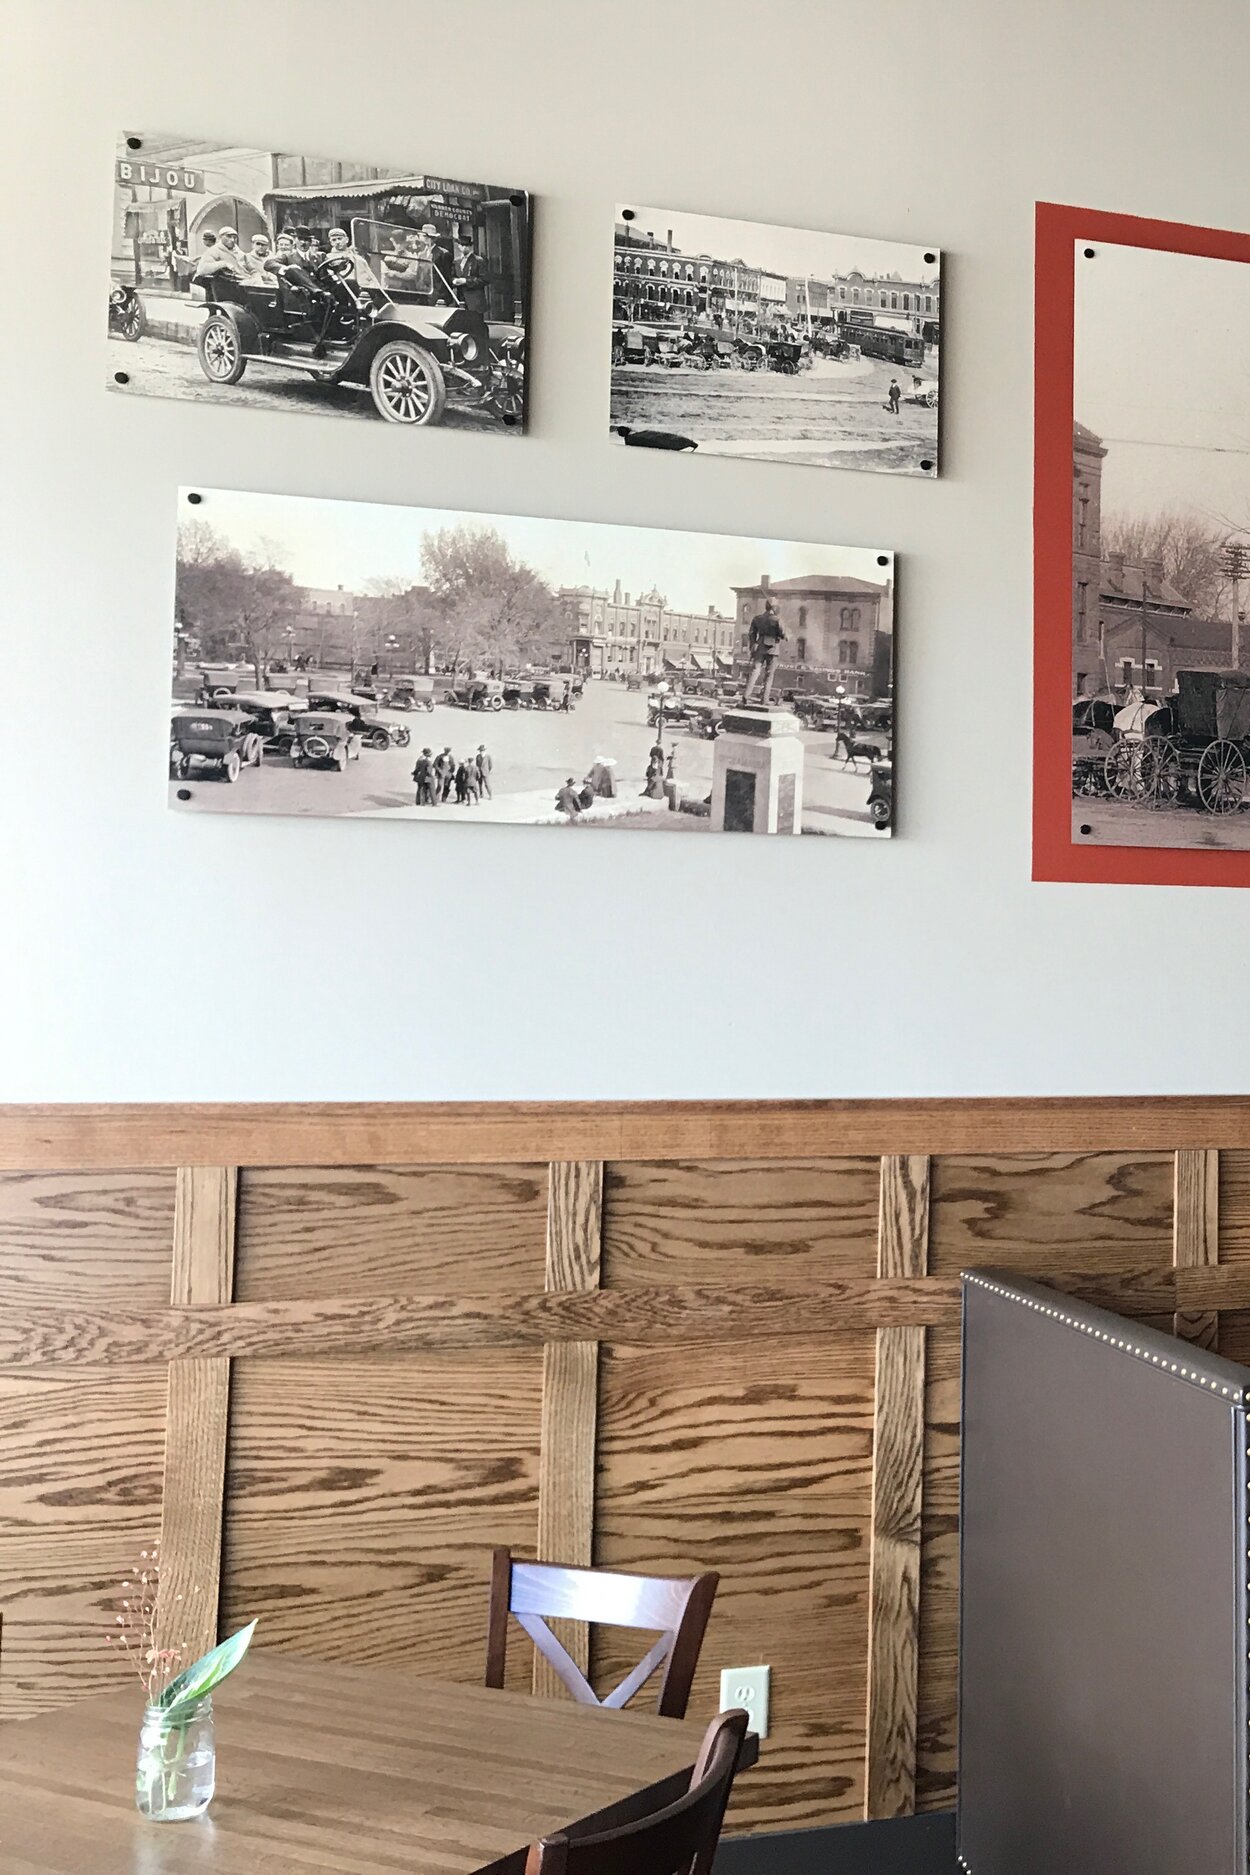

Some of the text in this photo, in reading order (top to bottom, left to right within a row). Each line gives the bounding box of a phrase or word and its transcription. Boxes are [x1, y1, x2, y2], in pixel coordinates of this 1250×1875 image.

[120, 162, 195, 188] BIJOU
[426, 179, 441, 190] CITY
[434, 209, 470, 221] DEMOCRAT
